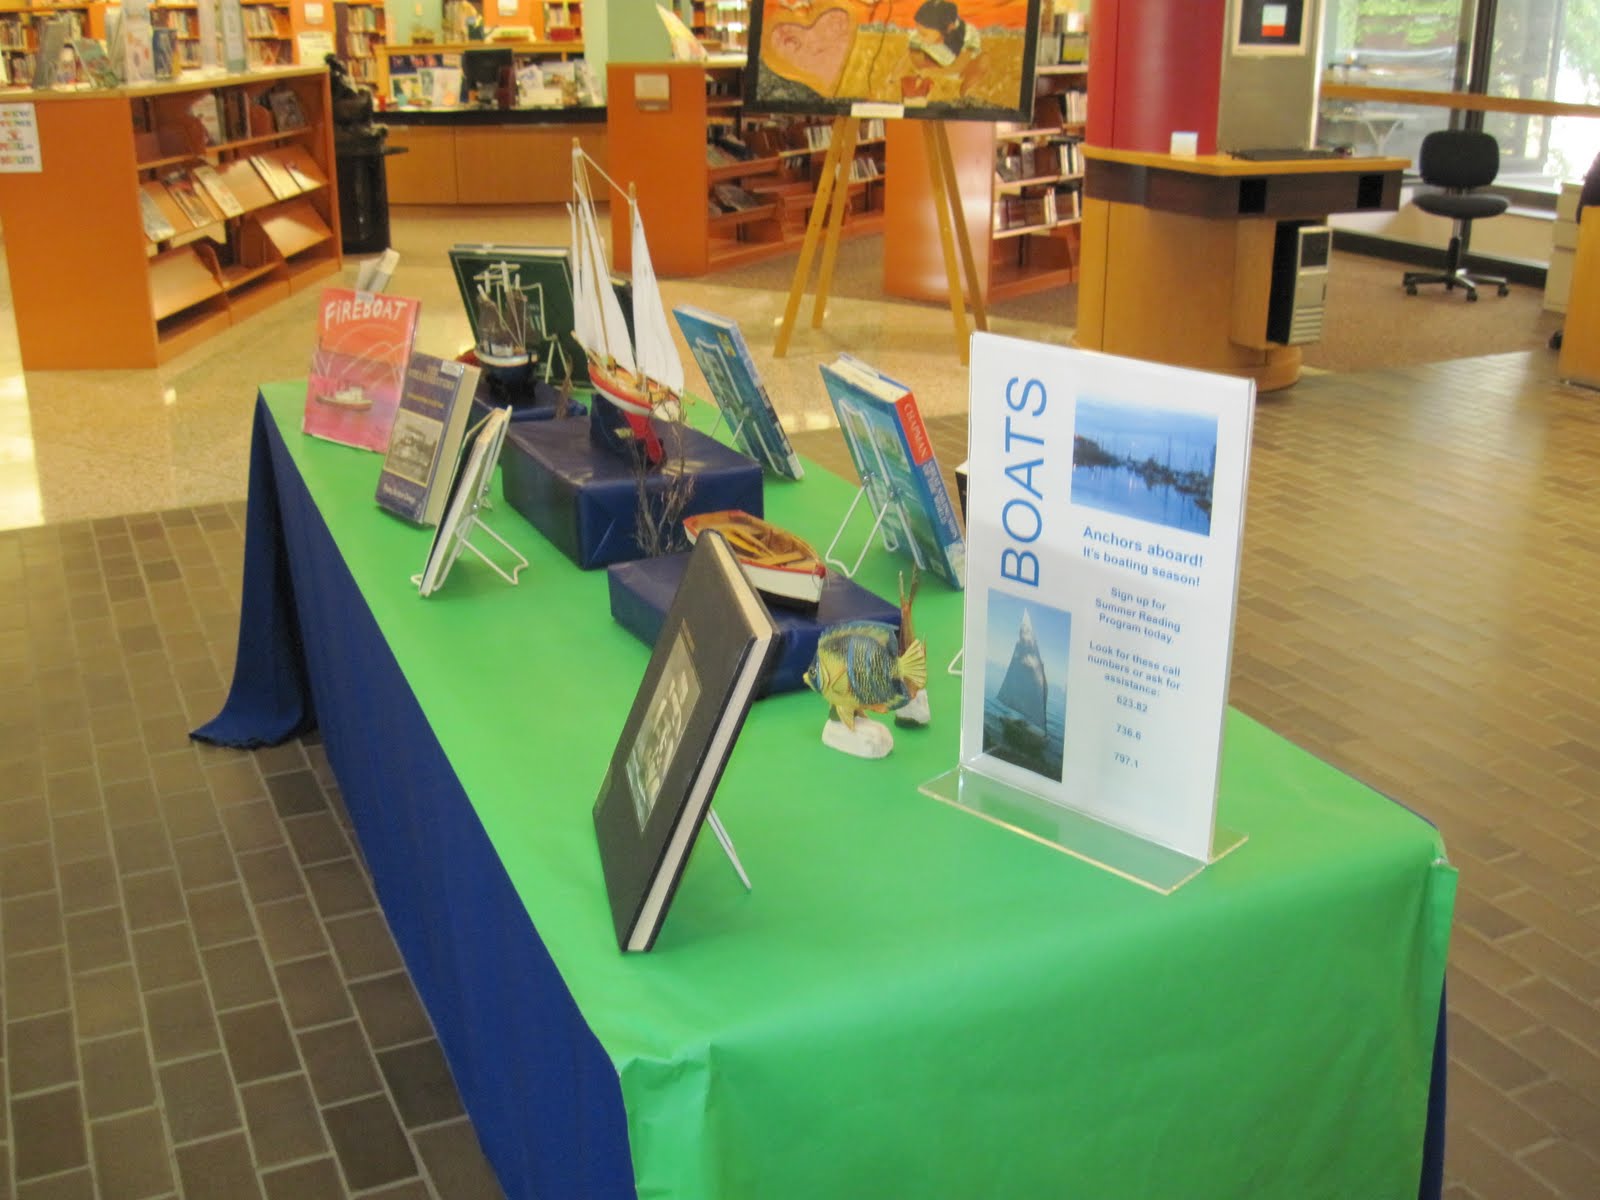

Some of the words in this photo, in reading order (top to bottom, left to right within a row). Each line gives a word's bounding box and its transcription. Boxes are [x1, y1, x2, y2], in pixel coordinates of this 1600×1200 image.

[1001, 376, 1048, 588] BOATS
[1083, 526, 1142, 552] Anchors
[1147, 543, 1204, 568] aboard!
[1083, 545, 1101, 561] It's
[1103, 551, 1149, 576] boating
[1152, 566, 1201, 588] season!
[1095, 597, 1137, 618] Summer
[1139, 610, 1181, 633] Reading
[1110, 586, 1134, 602] Sign
[1136, 596, 1150, 608] up
[1152, 598, 1167, 611] for
[1099, 612, 1141, 633] Program
[1087, 654, 1130, 674] numbers
[1132, 667, 1144, 679] or
[1145, 672, 1163, 685] ask
[1166, 677, 1180, 691] for
[1089, 640, 1114, 655] Look
[1116, 648, 1130, 660] for
[1132, 653, 1160, 670] these
[1162, 664, 1181, 677] call
[1113, 752, 1138, 769] 797.1
